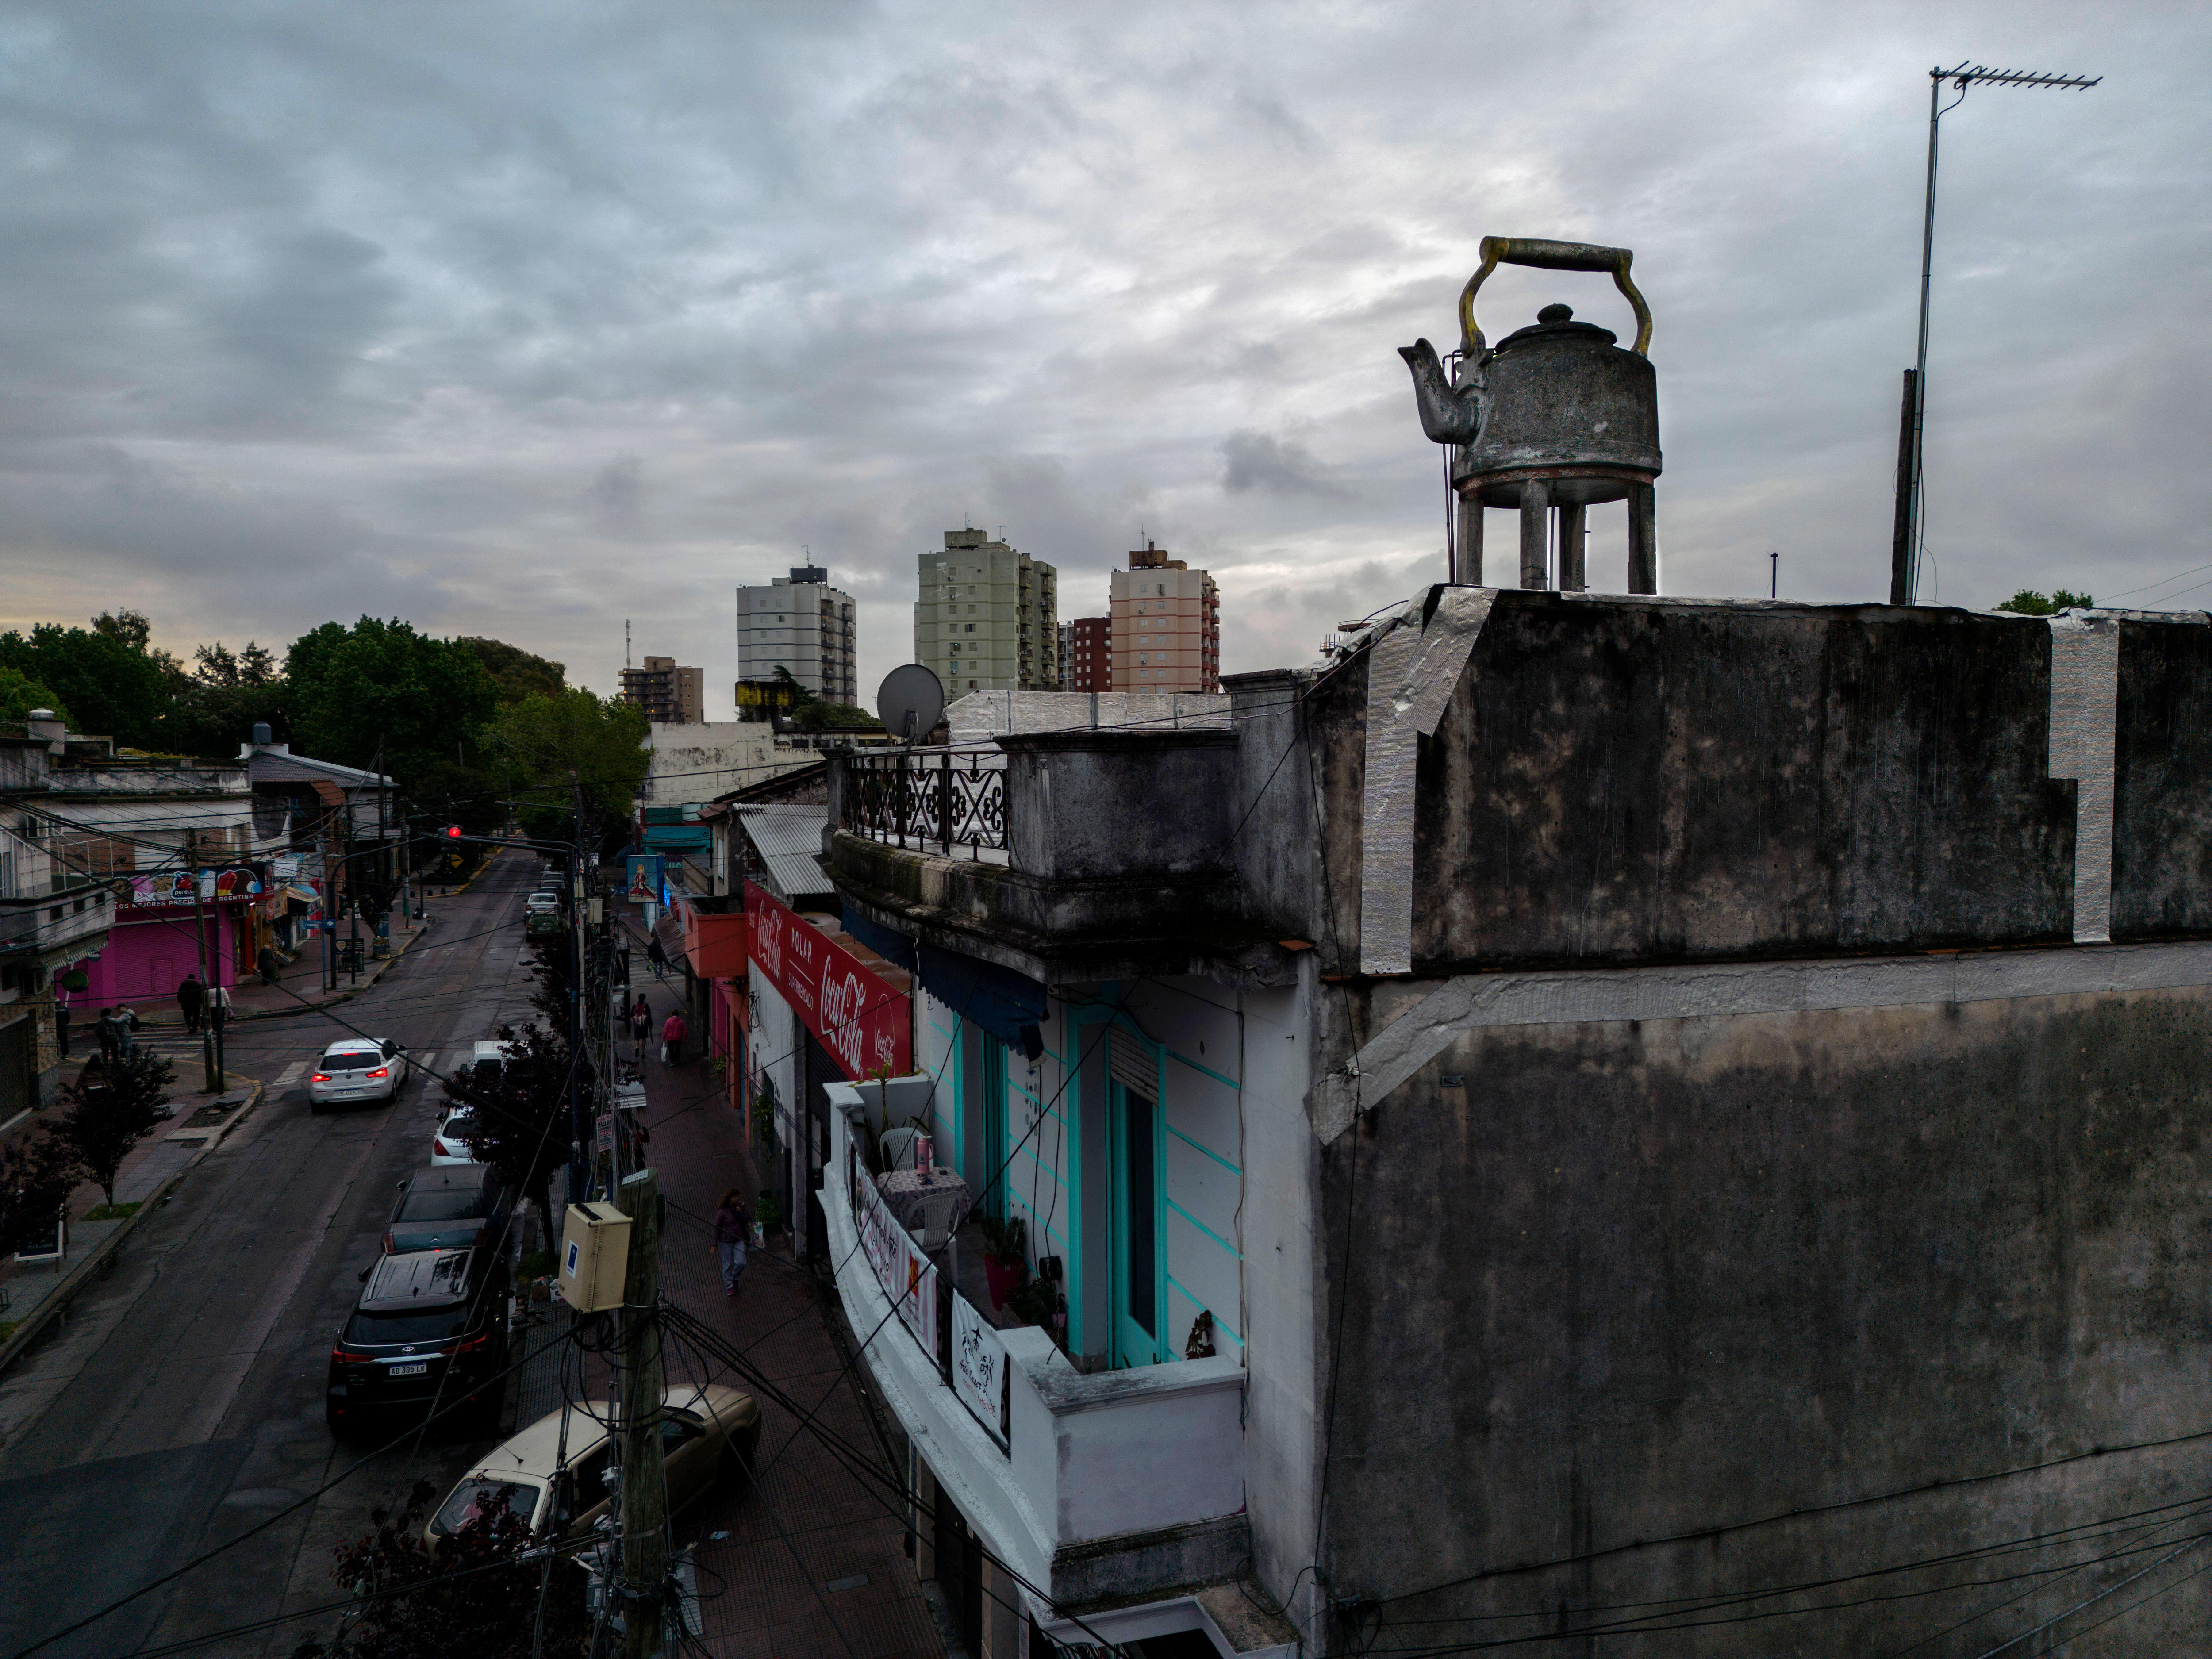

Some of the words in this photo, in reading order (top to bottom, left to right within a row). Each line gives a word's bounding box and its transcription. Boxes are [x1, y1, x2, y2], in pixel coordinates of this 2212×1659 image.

[214, 894, 253, 902] RGENTINA
[758, 899, 782, 979] Coca-Cola
[791, 927, 811, 964] POLAR
[788, 972, 813, 1011] SUPERMERCADO
[820, 954, 867, 1074] Coca-Cola
[959, 1359, 968, 1375] Arte
